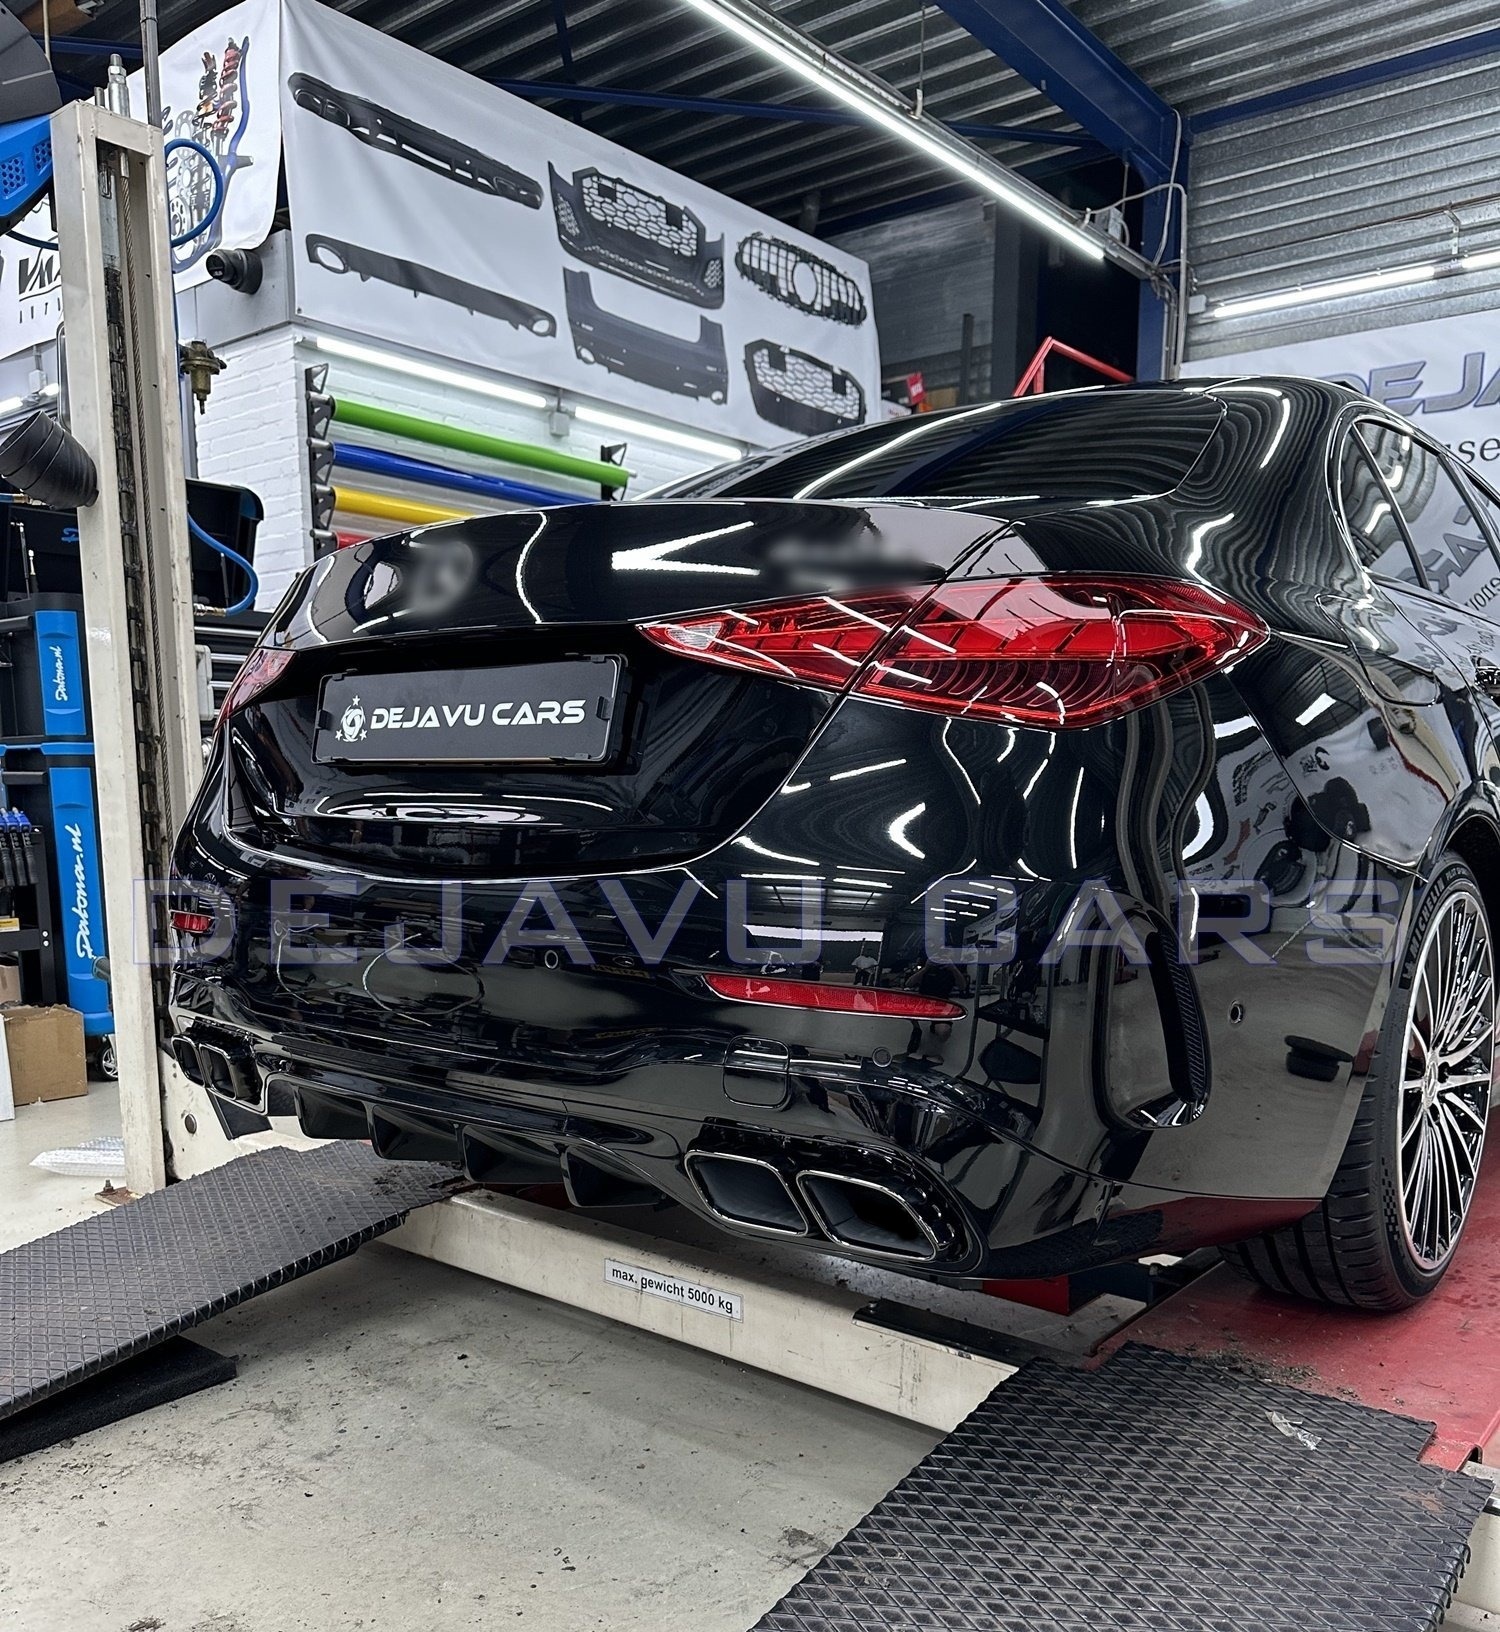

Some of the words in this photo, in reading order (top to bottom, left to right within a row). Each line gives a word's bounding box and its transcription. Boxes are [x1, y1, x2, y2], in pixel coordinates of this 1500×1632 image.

[19, 254, 61, 295] VM
[370, 704, 486, 729] DEJAVU
[492, 699, 586, 726] CARS
[1409, 877, 1445, 959] MICHELIN
[612, 1268, 638, 1284] max.
[641, 1276, 685, 1297] gewicht
[687, 1288, 715, 1306] 5000
[718, 1296, 733, 1314] kg
